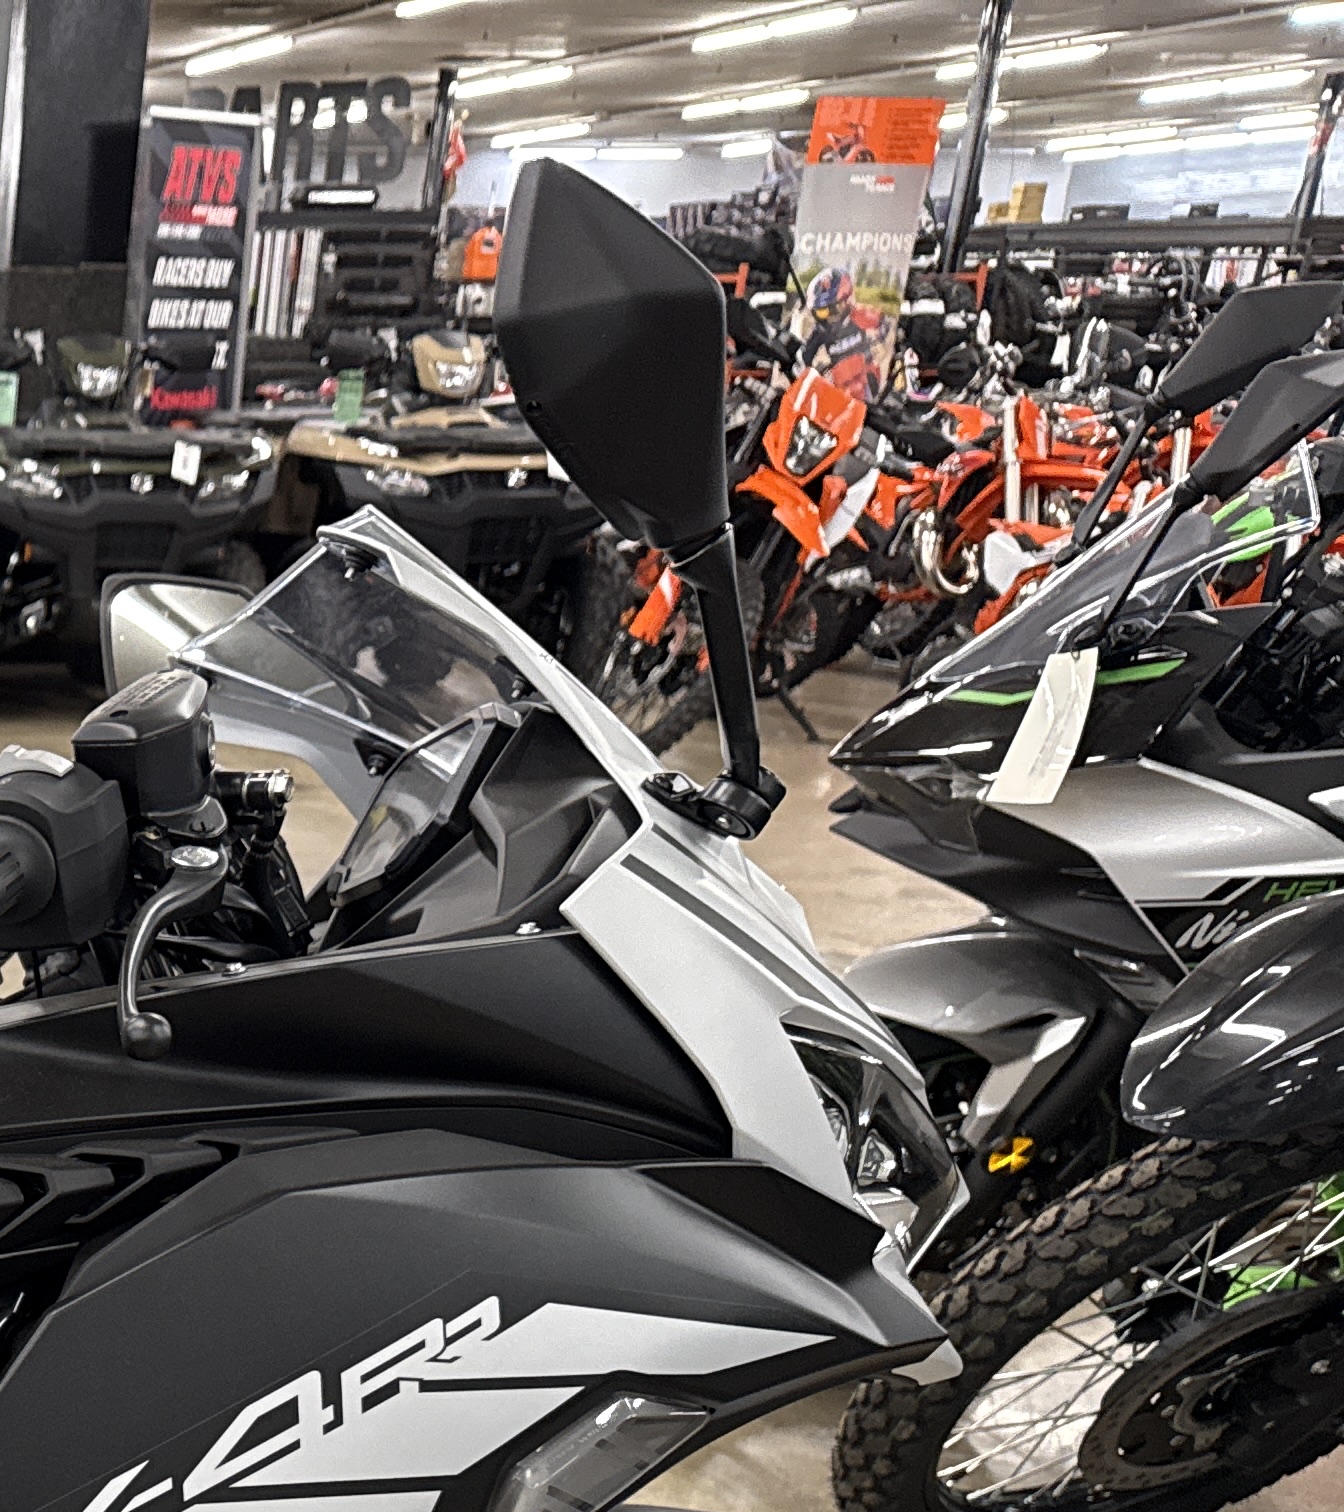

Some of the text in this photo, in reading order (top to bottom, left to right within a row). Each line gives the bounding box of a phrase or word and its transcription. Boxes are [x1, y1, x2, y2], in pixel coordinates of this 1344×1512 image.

[185, 76, 411, 184] RTS
[161, 145, 242, 204] ATVS
[799, 232, 914, 255] CHAMPIONS
